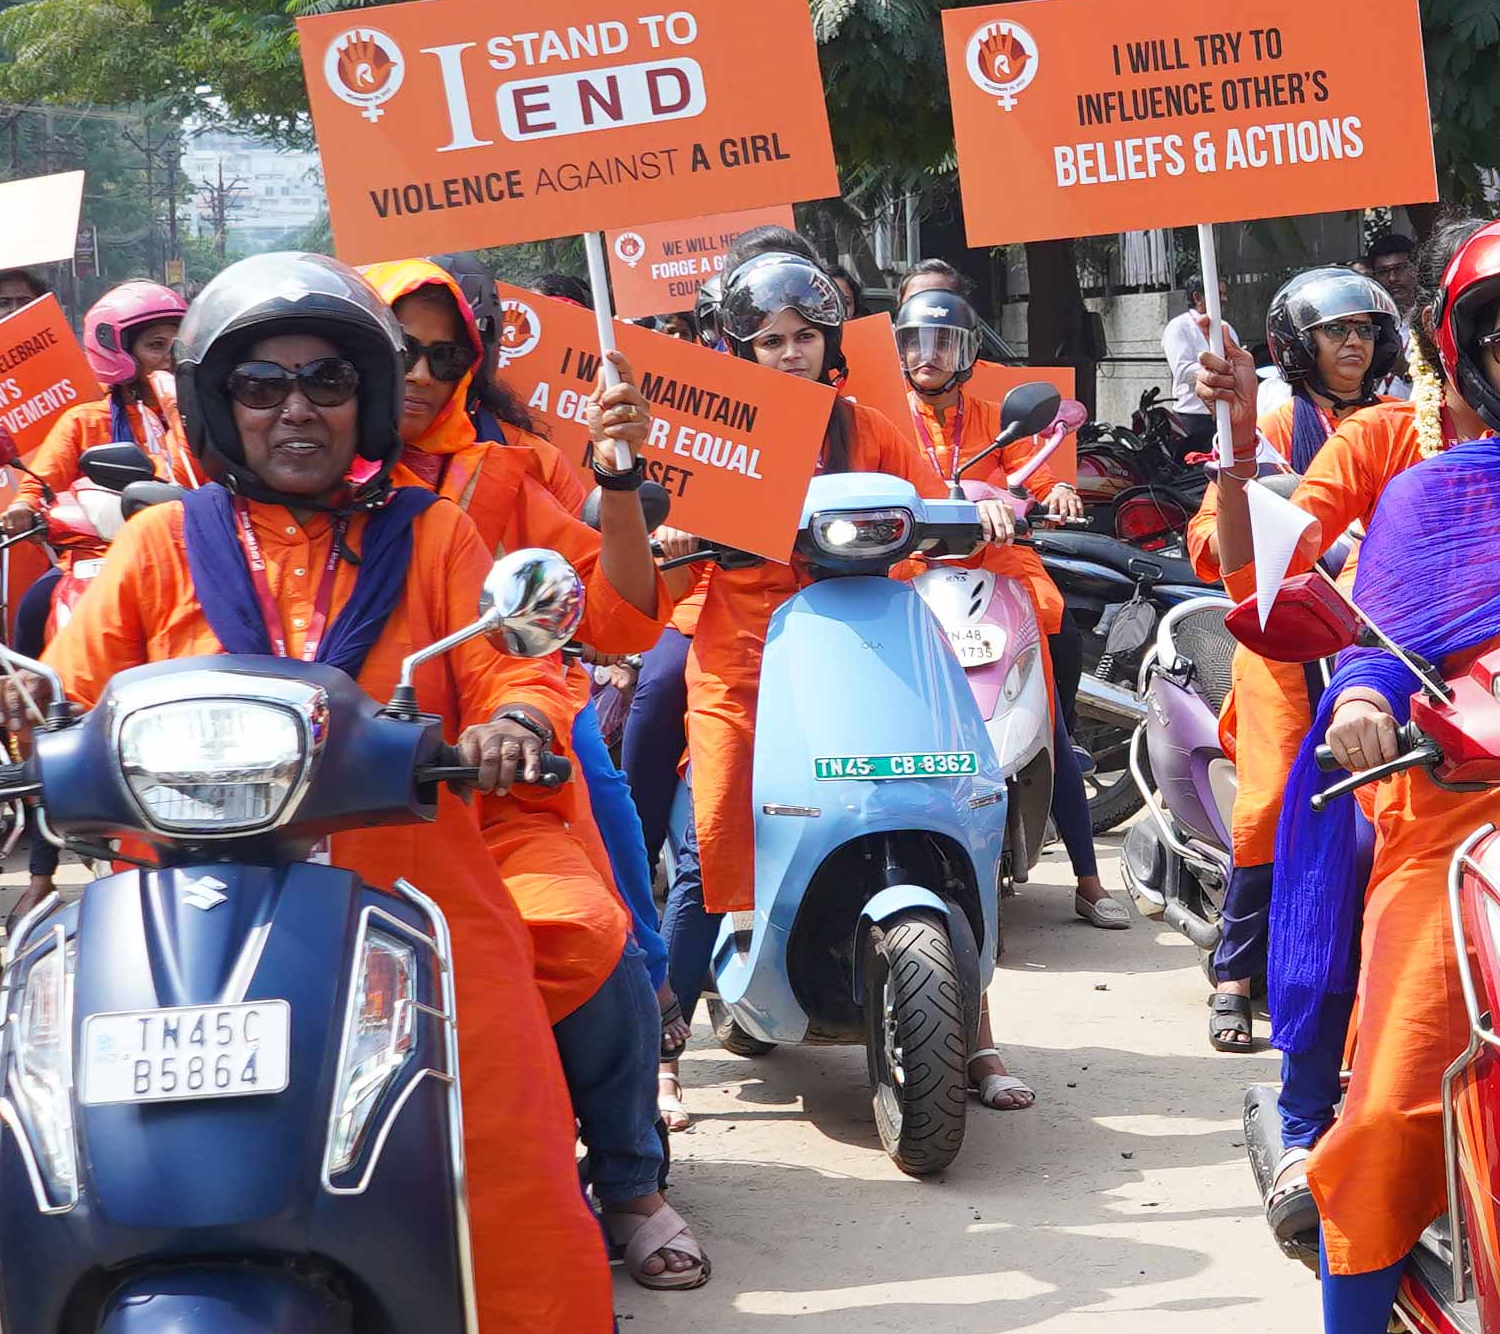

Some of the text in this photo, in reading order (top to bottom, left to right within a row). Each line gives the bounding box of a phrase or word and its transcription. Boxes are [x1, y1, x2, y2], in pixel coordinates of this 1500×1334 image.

[487, 10, 698, 71] STAND TO
[1112, 27, 1282, 75] I WILL TRY TO
[420, 42, 494, 153] I
[511, 67, 692, 135] END
[1077, 70, 1329, 126] INFLUENCE OTHER'S
[370, 132, 791, 219] VIOLENCE AGAINST A GIRL
[1053, 115, 1364, 188] BELIEFS & ACTIONS
[651, 258, 698, 280] FORGE
[701, 257, 711, 273] A
[662, 233, 739, 256] WE WILL HE
[668, 279, 704, 297] EQUA
[560, 347, 573, 374] I
[640, 372, 758, 433] MAINTAIN
[528, 382, 550, 412] A
[674, 426, 764, 480] EQUAL
[946, 630, 982, 642] N.48
[961, 647, 993, 659] 1735
[133, 1051, 260, 1095] B5864
